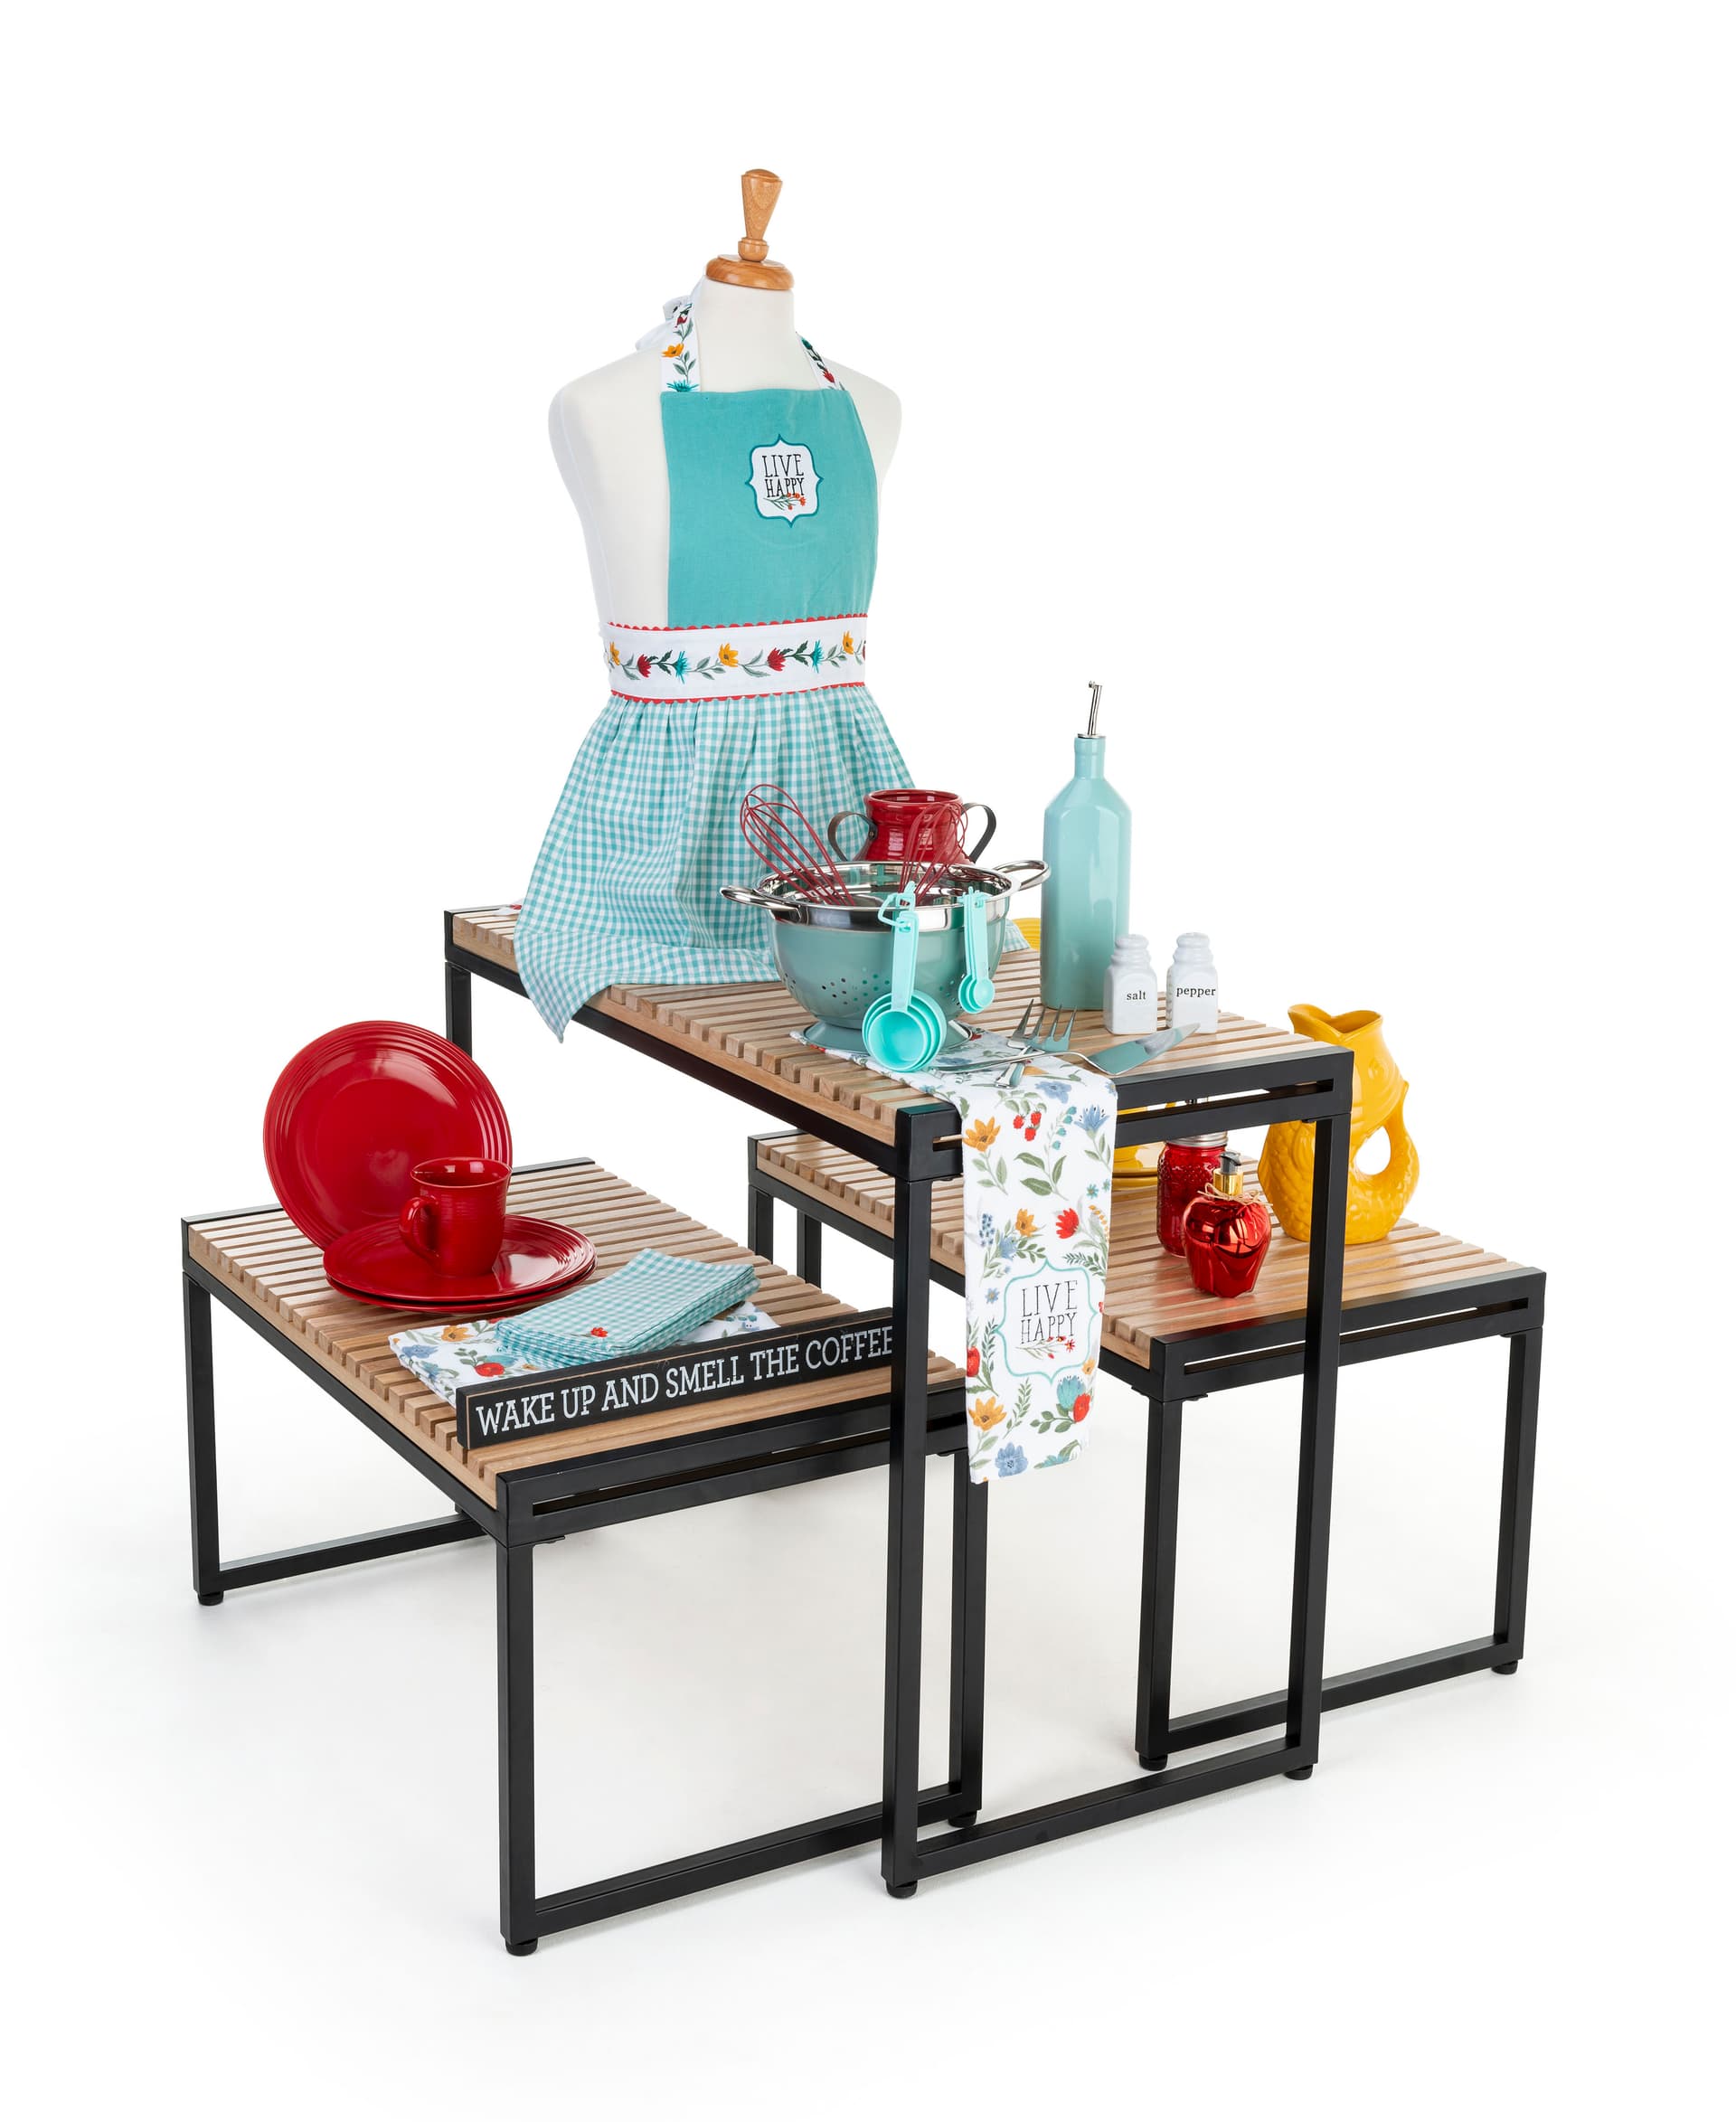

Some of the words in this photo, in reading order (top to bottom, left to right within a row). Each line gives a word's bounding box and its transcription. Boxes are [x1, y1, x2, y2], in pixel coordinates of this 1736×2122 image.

[762, 453, 805, 477] LIVE
[764, 477, 805, 498] HAPPY
[1127, 990, 1146, 1000] salt
[1176, 986, 1216, 997] pepper
[1021, 1279, 1078, 1317] LIVE
[1019, 1312, 1078, 1344] HAPPY
[476, 1391, 555, 1437] WAKE
[561, 1384, 596, 1419] UP
[600, 1372, 659, 1412] AND
[665, 1355, 745, 1398] SMELL
[750, 1344, 799, 1381] THE
[805, 1325, 893, 1370] COFFEE
